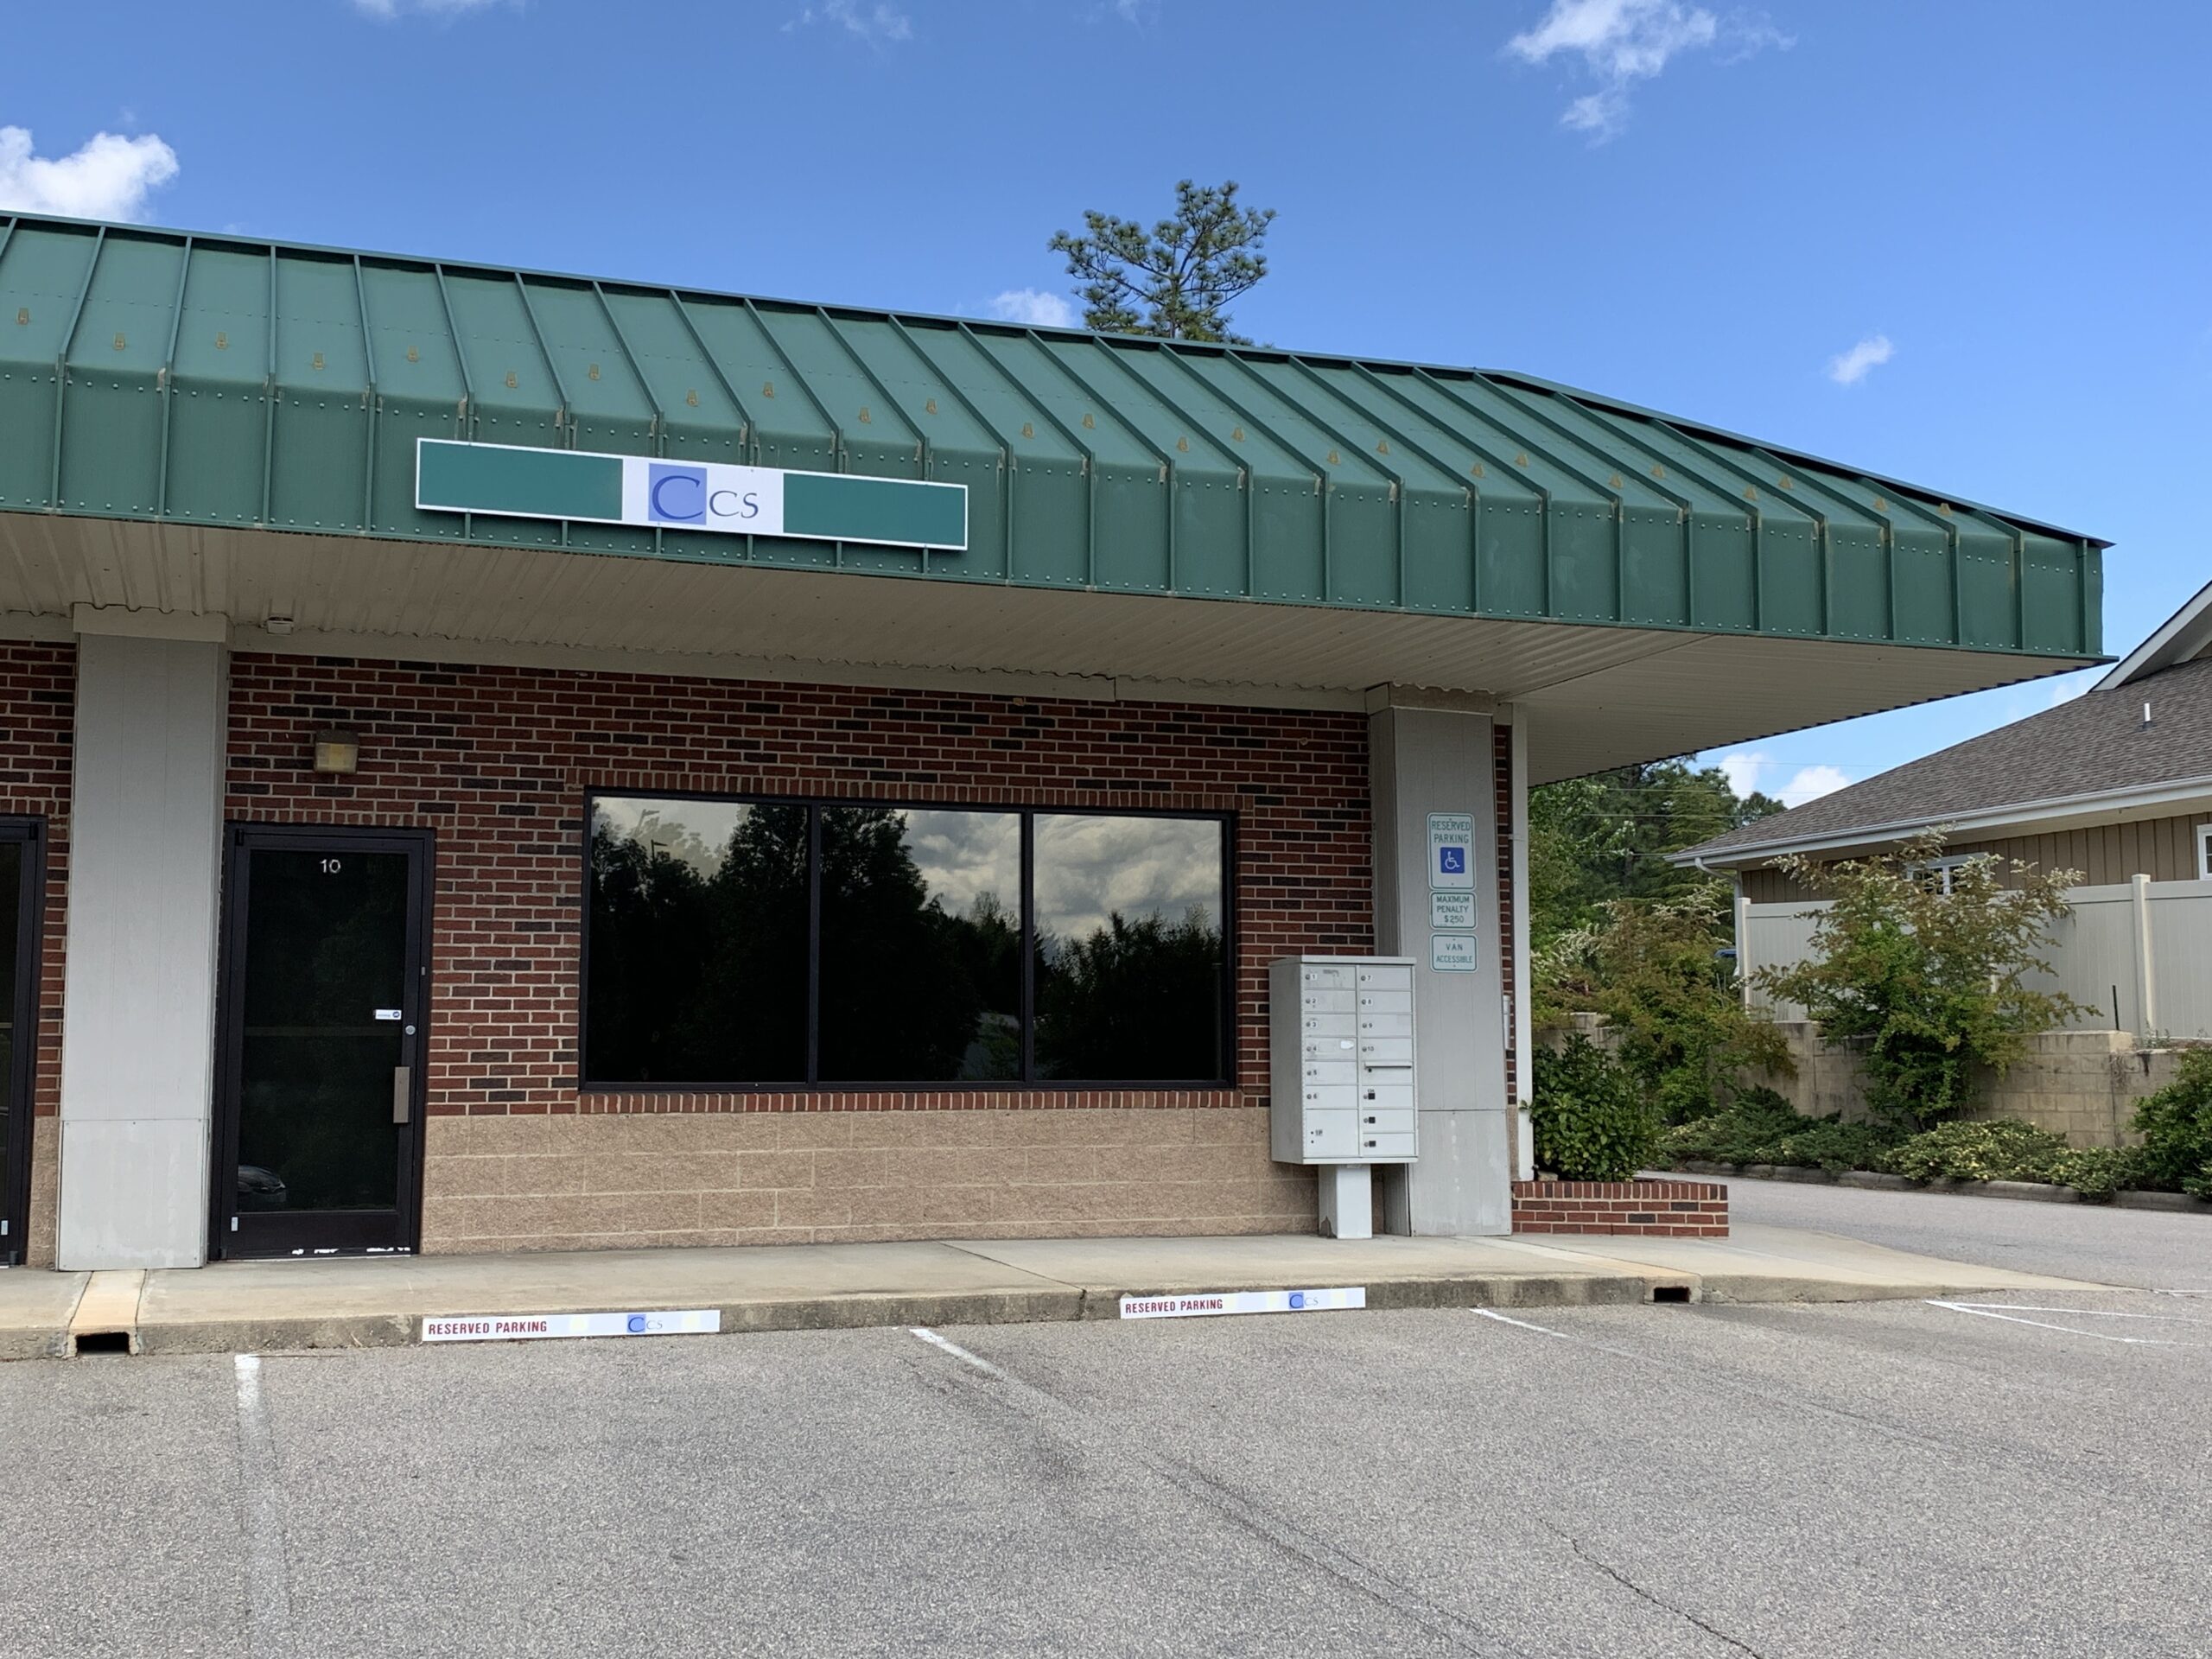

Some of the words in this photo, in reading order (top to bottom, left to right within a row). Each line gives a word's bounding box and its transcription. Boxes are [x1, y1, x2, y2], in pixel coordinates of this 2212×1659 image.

[1431, 820, 1471, 831] RESERVED
[1433, 834, 1470, 844] PARKING
[320, 858, 341, 874] 10
[1436, 895, 1470, 904] MAXIMUM
[1436, 905, 1469, 913] PENALTY
[1444, 915, 1465, 924] $250
[1446, 943, 1463, 951] VAN
[1435, 955, 1473, 963] ACCESSIBLE
[1125, 1300, 1176, 1313] RESERVED
[1180, 1299, 1224, 1312] PARKING
[429, 1323, 490, 1336] RESERVED
[495, 1320, 548, 1334] PARKING
